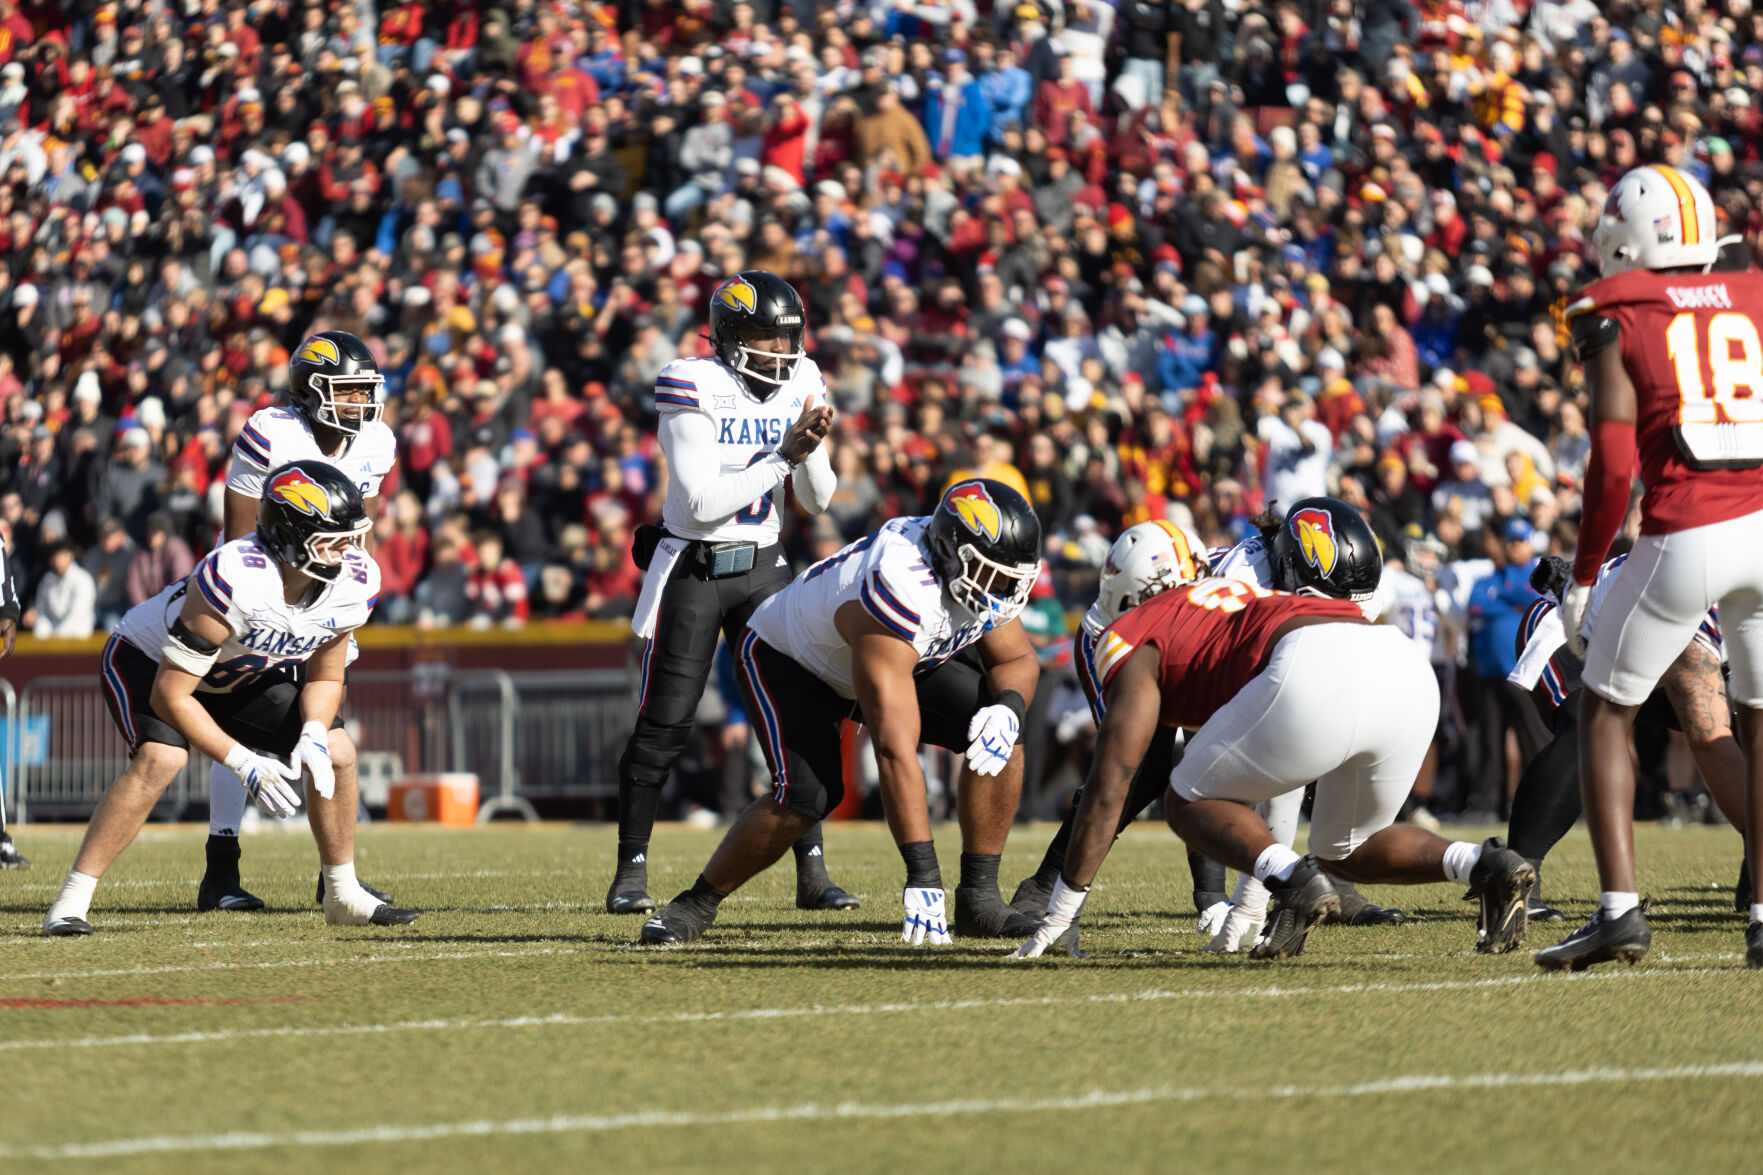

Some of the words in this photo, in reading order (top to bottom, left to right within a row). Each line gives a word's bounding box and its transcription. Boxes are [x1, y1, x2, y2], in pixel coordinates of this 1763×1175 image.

[1666, 312, 1763, 424] 18
[718, 418, 793, 445] KANS
[238, 545, 267, 569] 88
